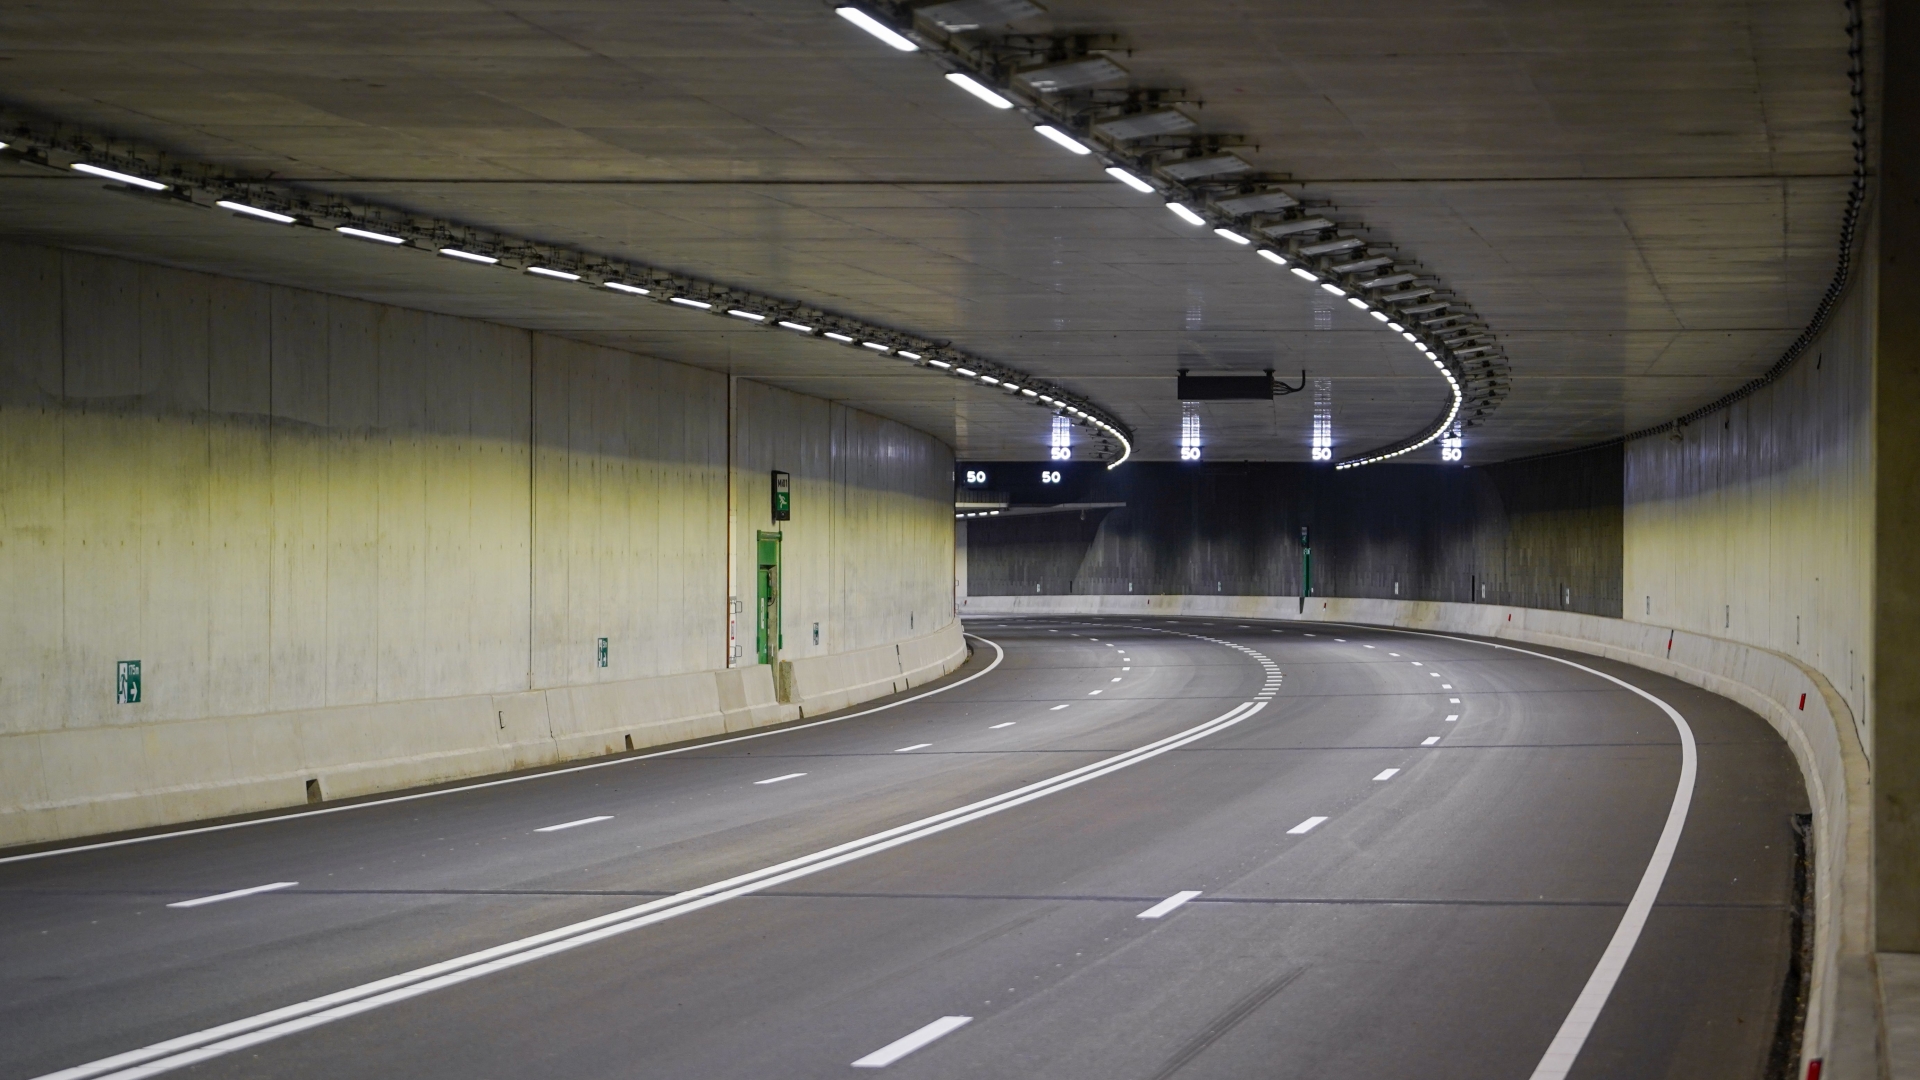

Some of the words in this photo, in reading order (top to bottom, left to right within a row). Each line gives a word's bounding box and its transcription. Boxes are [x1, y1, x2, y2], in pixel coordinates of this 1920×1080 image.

[1050, 448, 1071, 460] 50
[1180, 448, 1201, 460] 50
[1311, 448, 1332, 460] 50
[1441, 448, 1462, 460] 50
[966, 471, 986, 482] 50
[1042, 471, 1061, 483] 50
